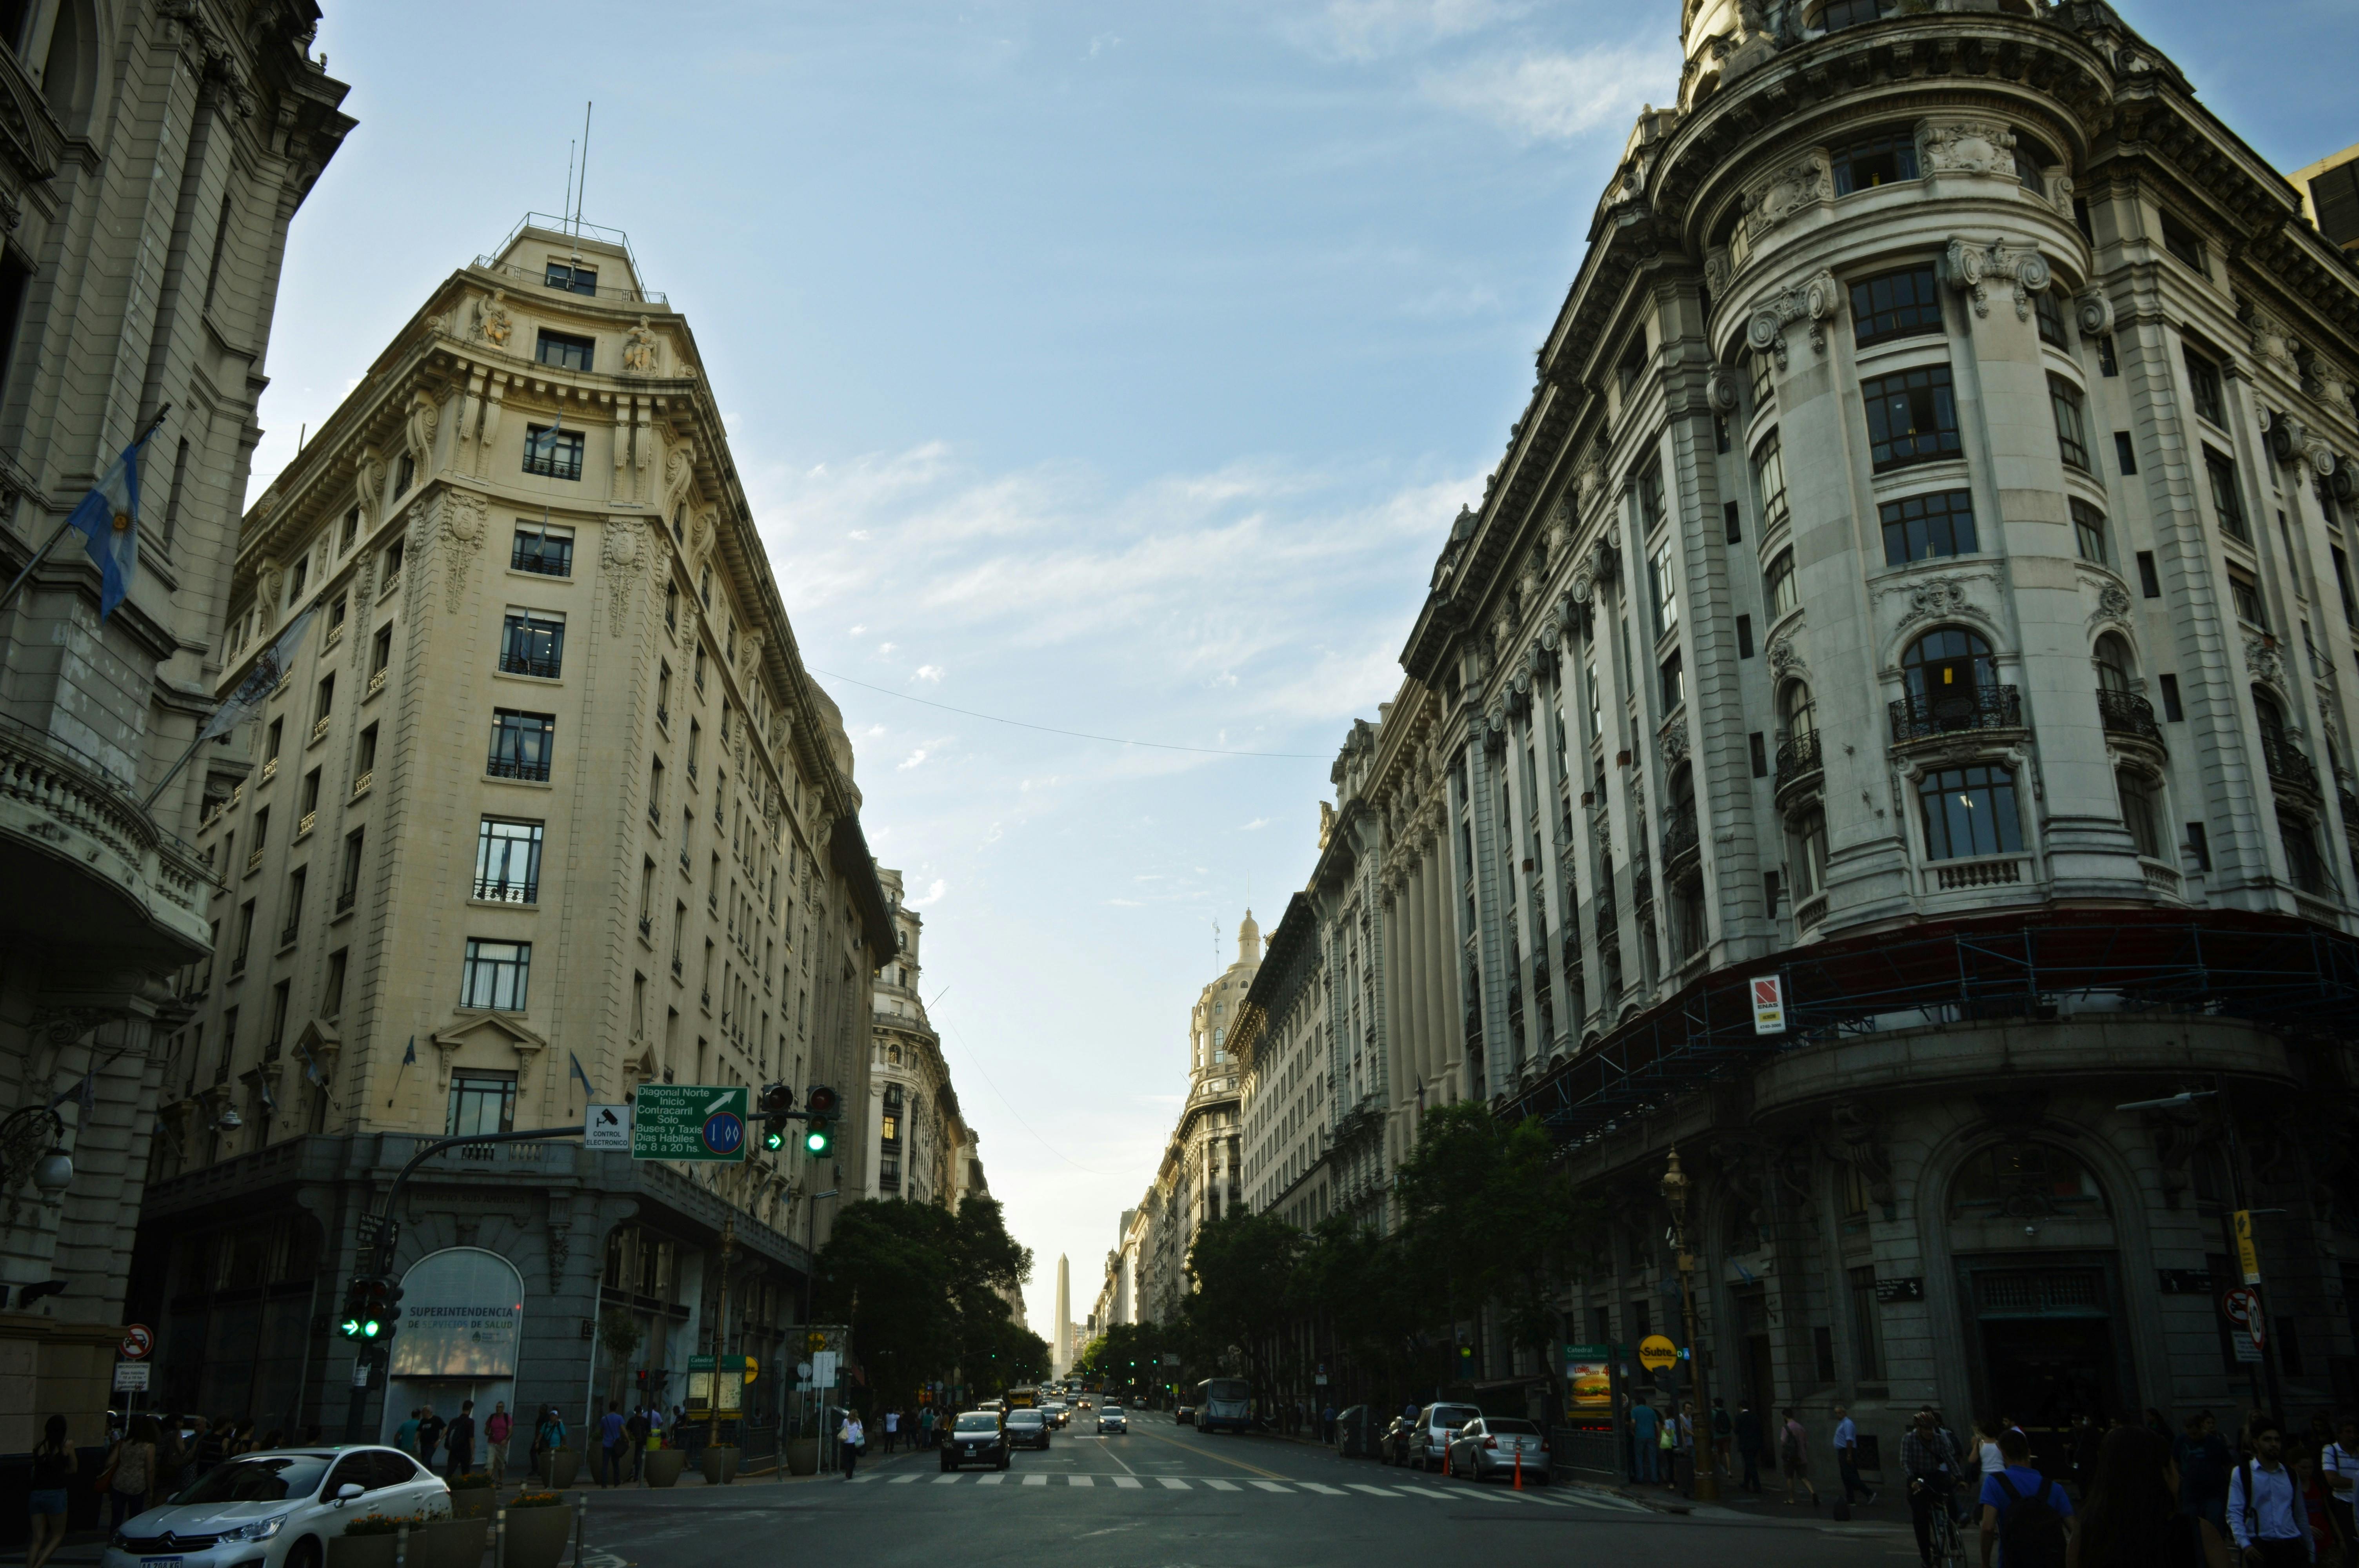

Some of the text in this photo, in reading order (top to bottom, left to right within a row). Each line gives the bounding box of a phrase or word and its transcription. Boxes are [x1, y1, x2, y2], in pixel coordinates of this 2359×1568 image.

[638, 1088, 709, 1097] Diagonal Norte
[660, 1097, 685, 1105] Inicio
[637, 1105, 693, 1115] Contracarril
[657, 1115, 679, 1124] Solo
[636, 1124, 702, 1134] Buses y Taxis
[636, 1132, 656, 1141] Días
[635, 1142, 647, 1151] de
[651, 1142, 657, 1151] 8
[670, 1143, 683, 1152] 20
[686, 1143, 700, 1152] hs.
[416, 1193, 458, 1201] EDIFICIO
[483, 1195, 525, 1204] AMERICA
[410, 1307, 513, 1317] SUPERINTENDENCIA
[422, 1320, 468, 1328] SERVICIOS
[2250, 1306, 2260, 1333] 10
[1643, 1347, 1673, 1356] Subte
[1319, 1363, 1324, 1373] E
